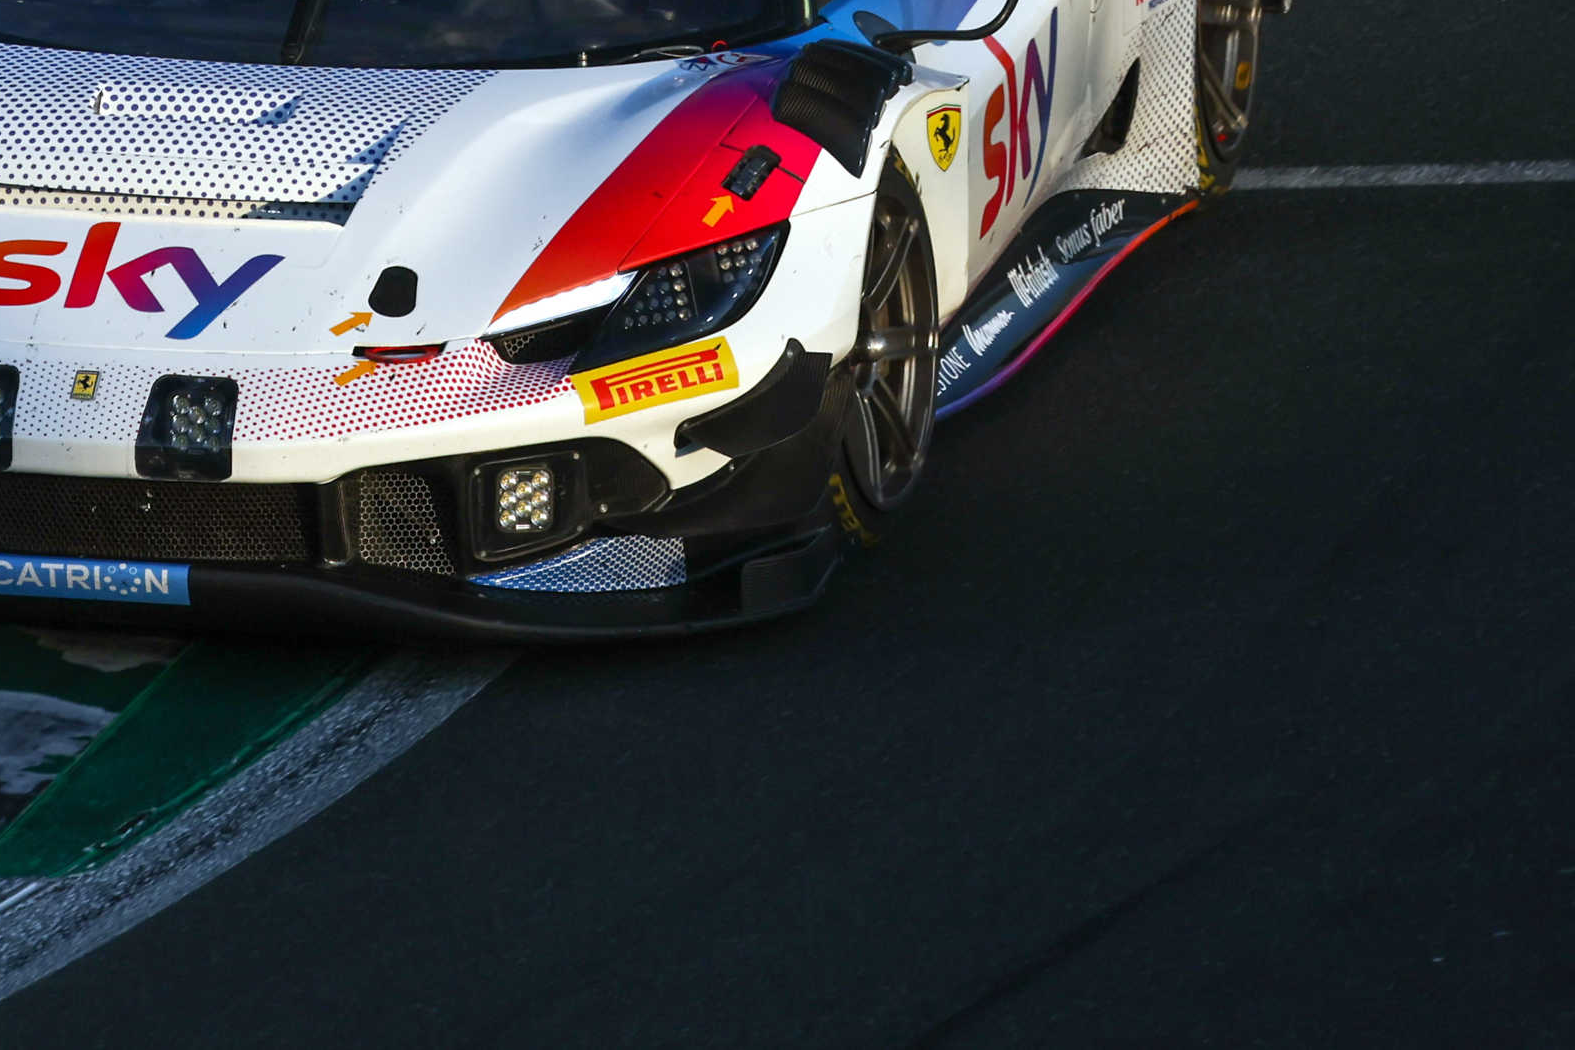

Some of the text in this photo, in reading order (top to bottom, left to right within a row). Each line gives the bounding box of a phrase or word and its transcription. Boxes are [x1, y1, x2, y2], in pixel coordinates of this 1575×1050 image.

[979, 6, 1058, 240] sky
[1090, 199, 1126, 247] faber
[590, 349, 724, 411] PIRELLI
